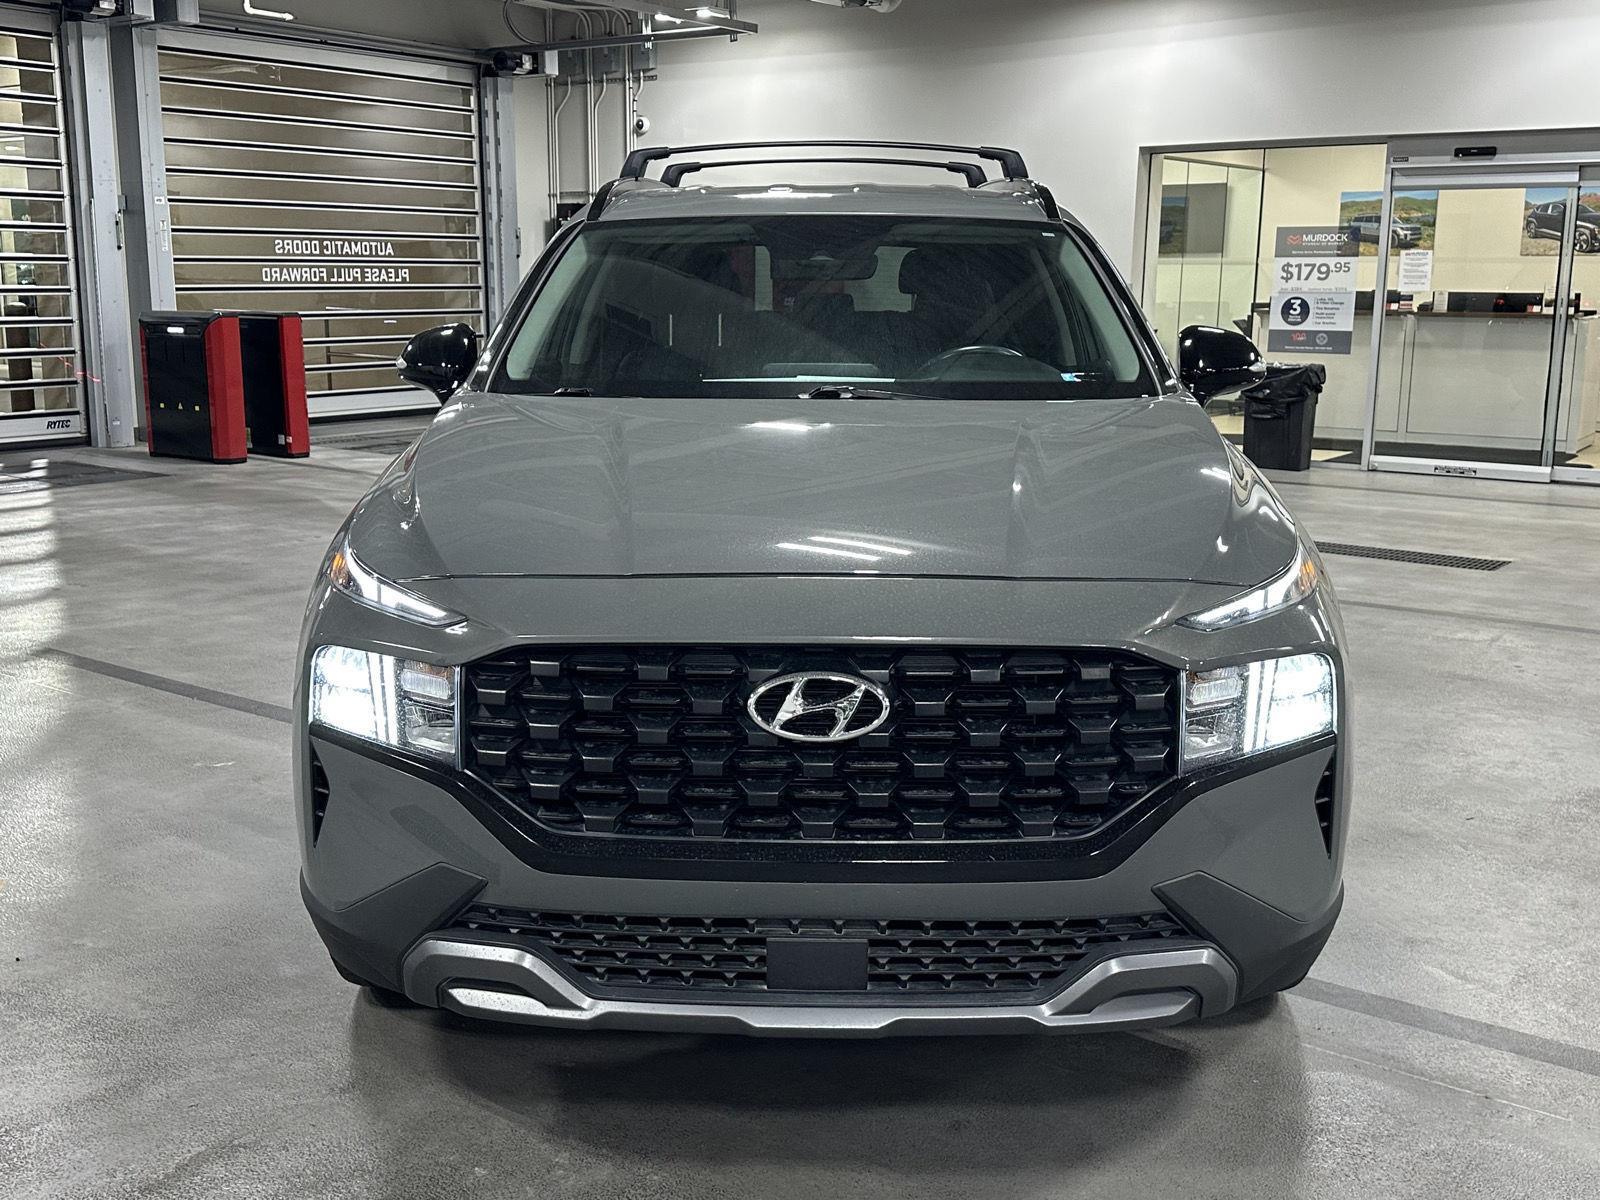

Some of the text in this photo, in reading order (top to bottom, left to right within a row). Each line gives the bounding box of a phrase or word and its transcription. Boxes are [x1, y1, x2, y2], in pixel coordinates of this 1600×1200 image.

[1302, 233, 1348, 242] MURDOCK
[1280, 262, 1351, 283] $179.95
[1289, 299, 1302, 315] 3
[46, 419, 71, 430] RYTEC
